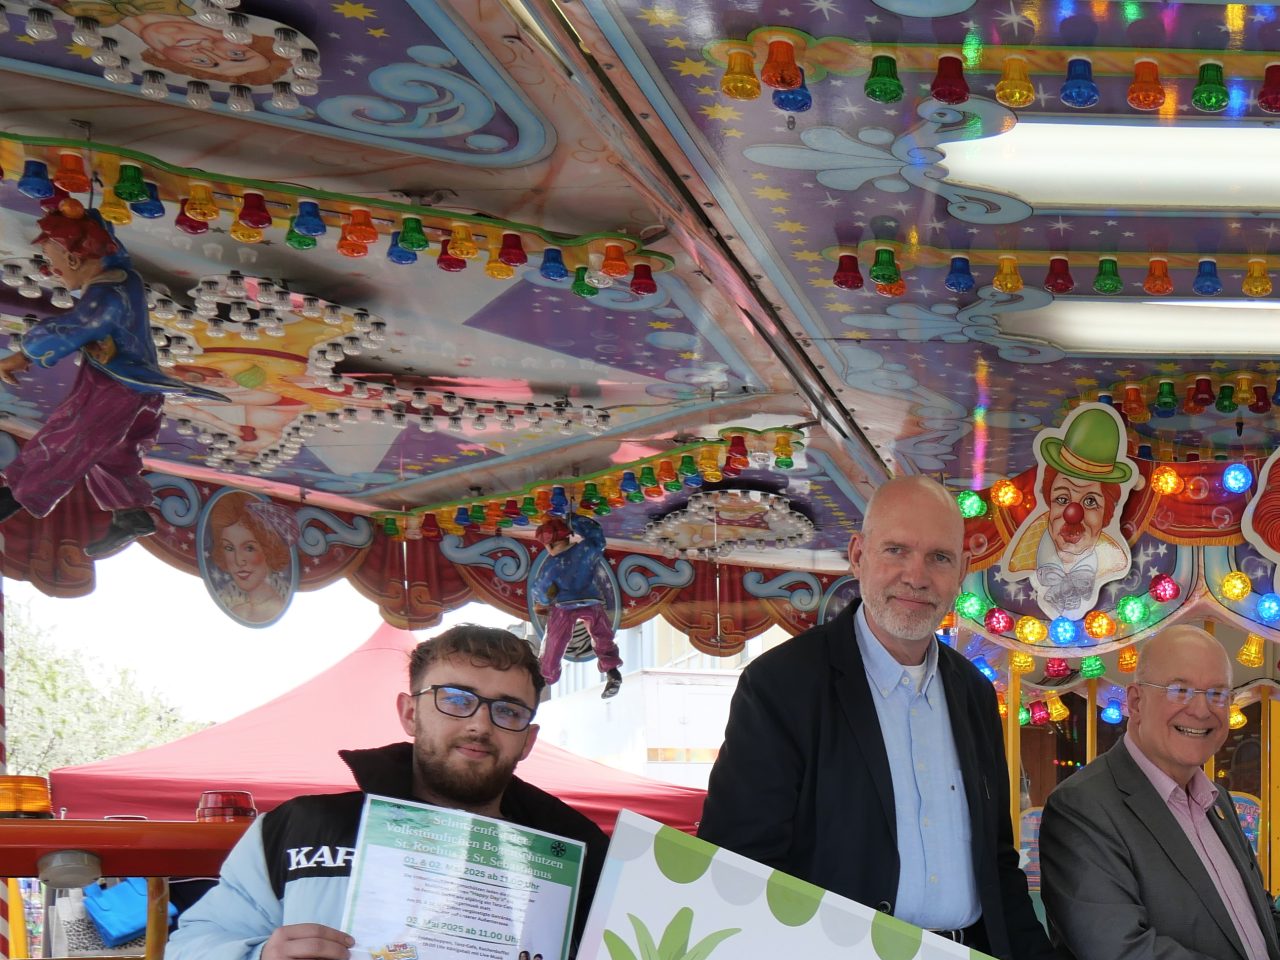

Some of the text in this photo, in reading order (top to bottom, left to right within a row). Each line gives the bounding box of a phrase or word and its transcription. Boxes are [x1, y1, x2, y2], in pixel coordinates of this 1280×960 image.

[463, 867, 486, 879] 2025
[487, 872, 498, 882] ab
[441, 922, 463, 933] 2025
[465, 927, 476, 936] ab
[479, 930, 503, 941] 11.00
